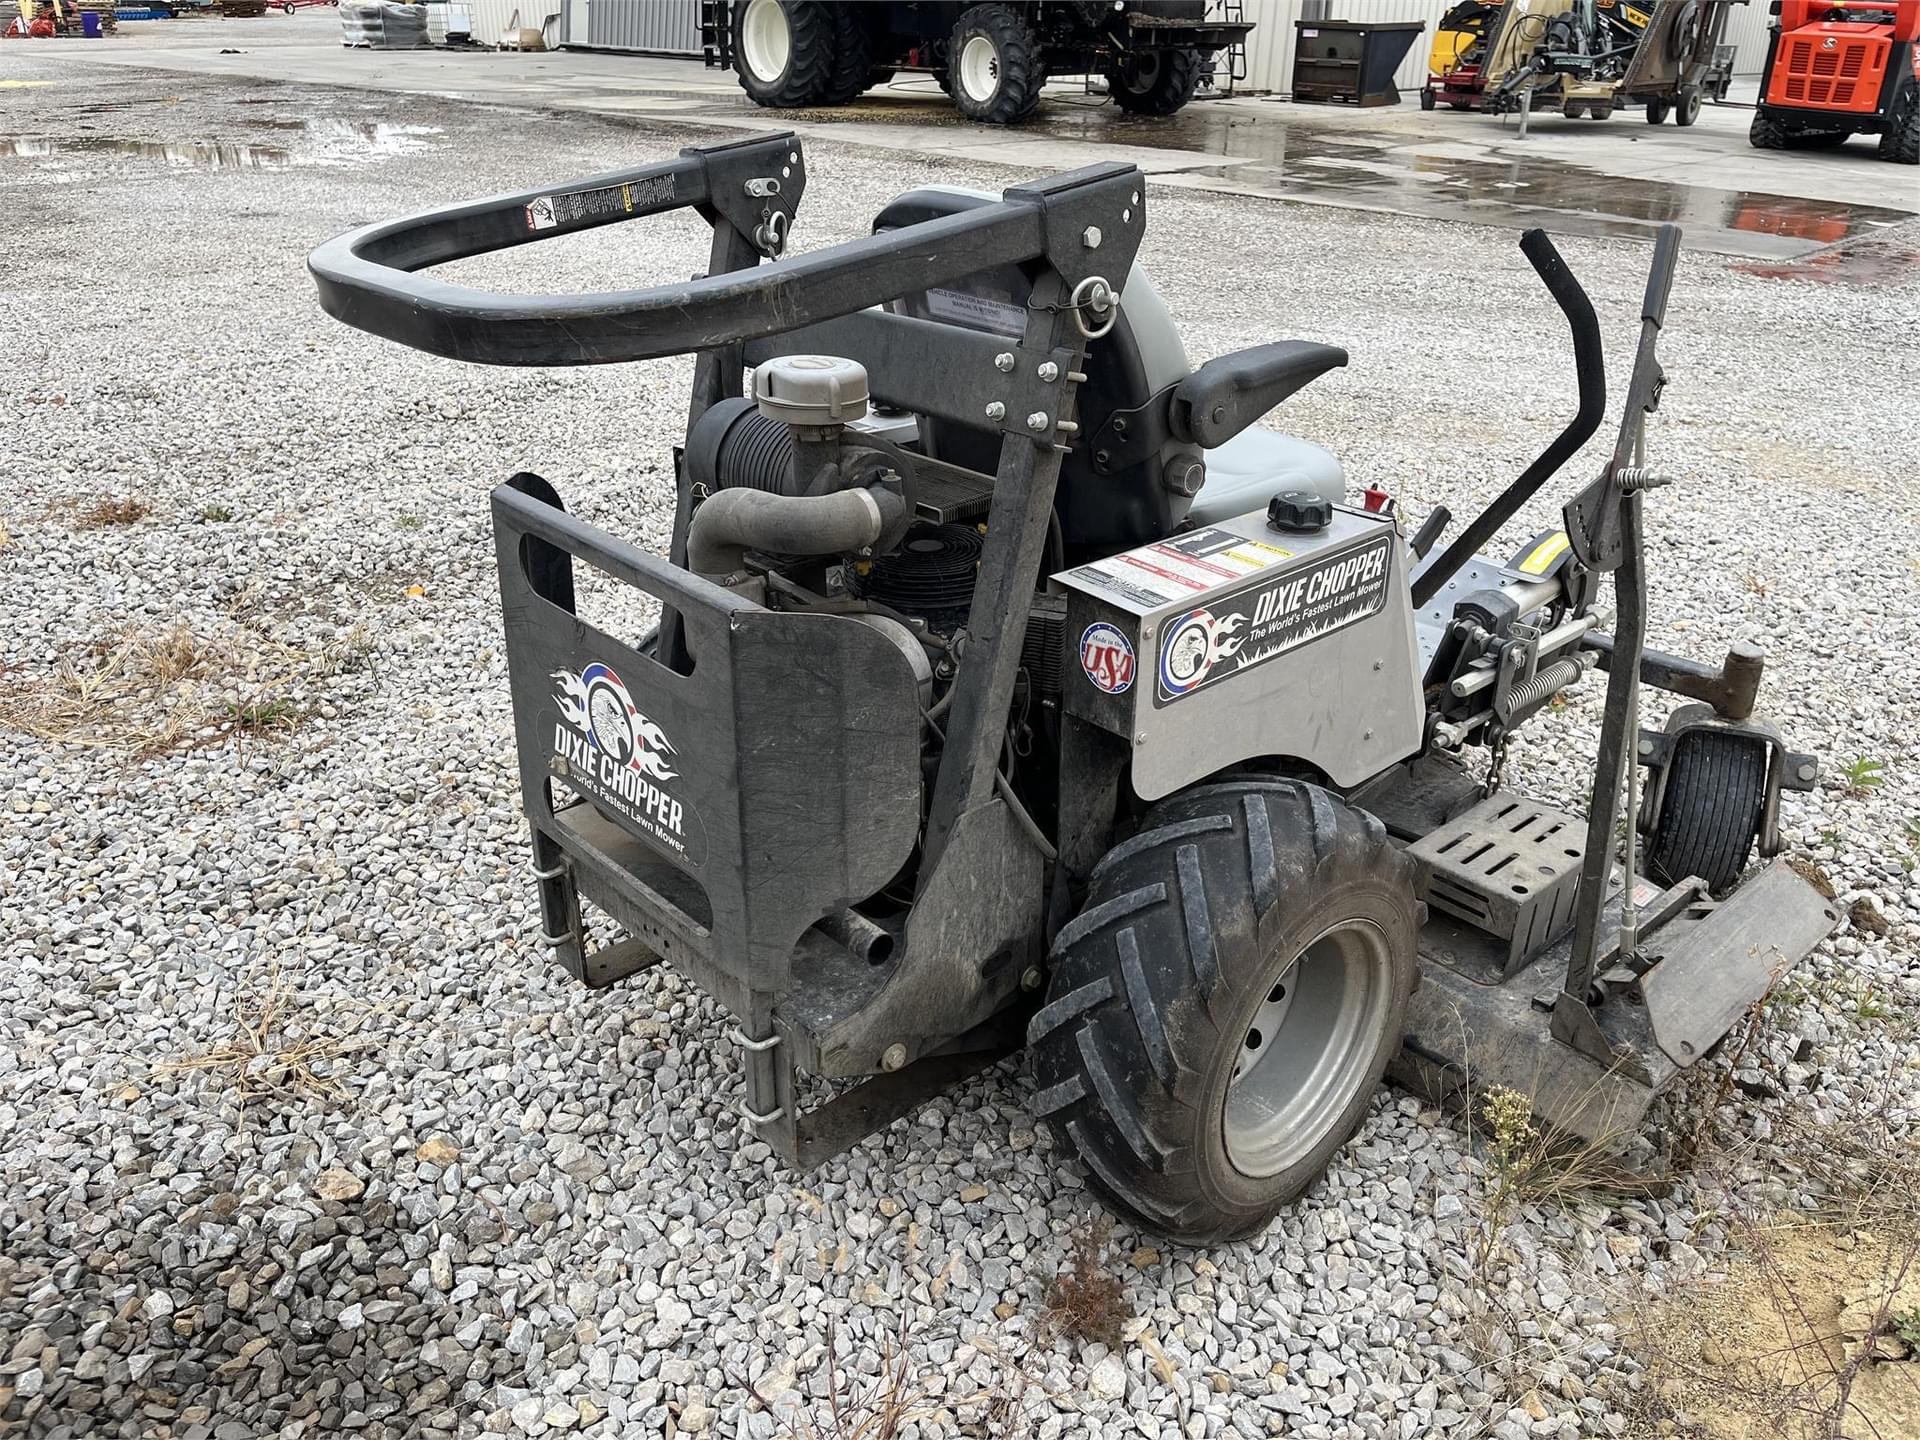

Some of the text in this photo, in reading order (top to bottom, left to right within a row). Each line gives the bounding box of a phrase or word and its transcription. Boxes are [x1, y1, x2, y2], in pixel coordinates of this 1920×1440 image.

[1250, 579, 1383, 641] The World's Fastest Lawn Mower
[1252, 577, 1307, 627] DIXIE
[1306, 546, 1386, 604] CHOPPER
[1084, 643, 1133, 690] USA
[1093, 634, 1107, 643] Made
[554, 722, 683, 836] DIXIE CHOPPER
[600, 786, 630, 816] Fastest
[631, 807, 654, 833] Lawn
[655, 828, 685, 853] Mower
